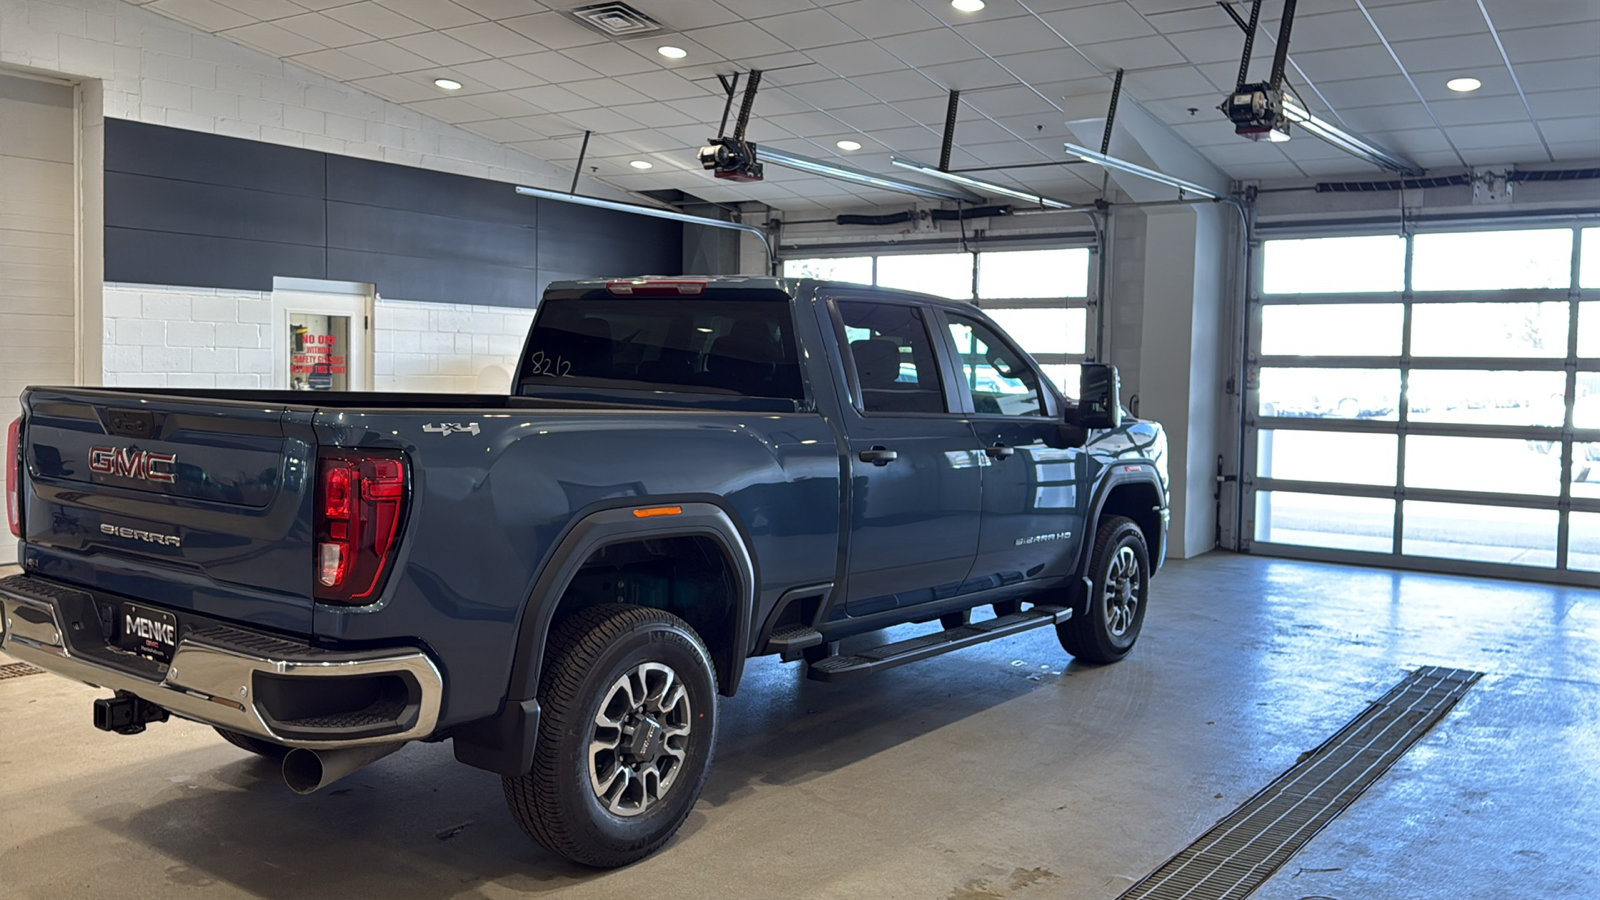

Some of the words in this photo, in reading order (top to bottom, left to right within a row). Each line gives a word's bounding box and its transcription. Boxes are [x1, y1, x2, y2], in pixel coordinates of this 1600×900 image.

[302, 335, 314, 343] NO
[318, 335, 336, 344] ONE
[532, 350, 576, 378] 8212
[88, 447, 177, 483] GMC
[100, 523, 181, 547] SIERRA
[1016, 534, 1055, 545] SIERRA
[126, 614, 175, 647] MENKE
